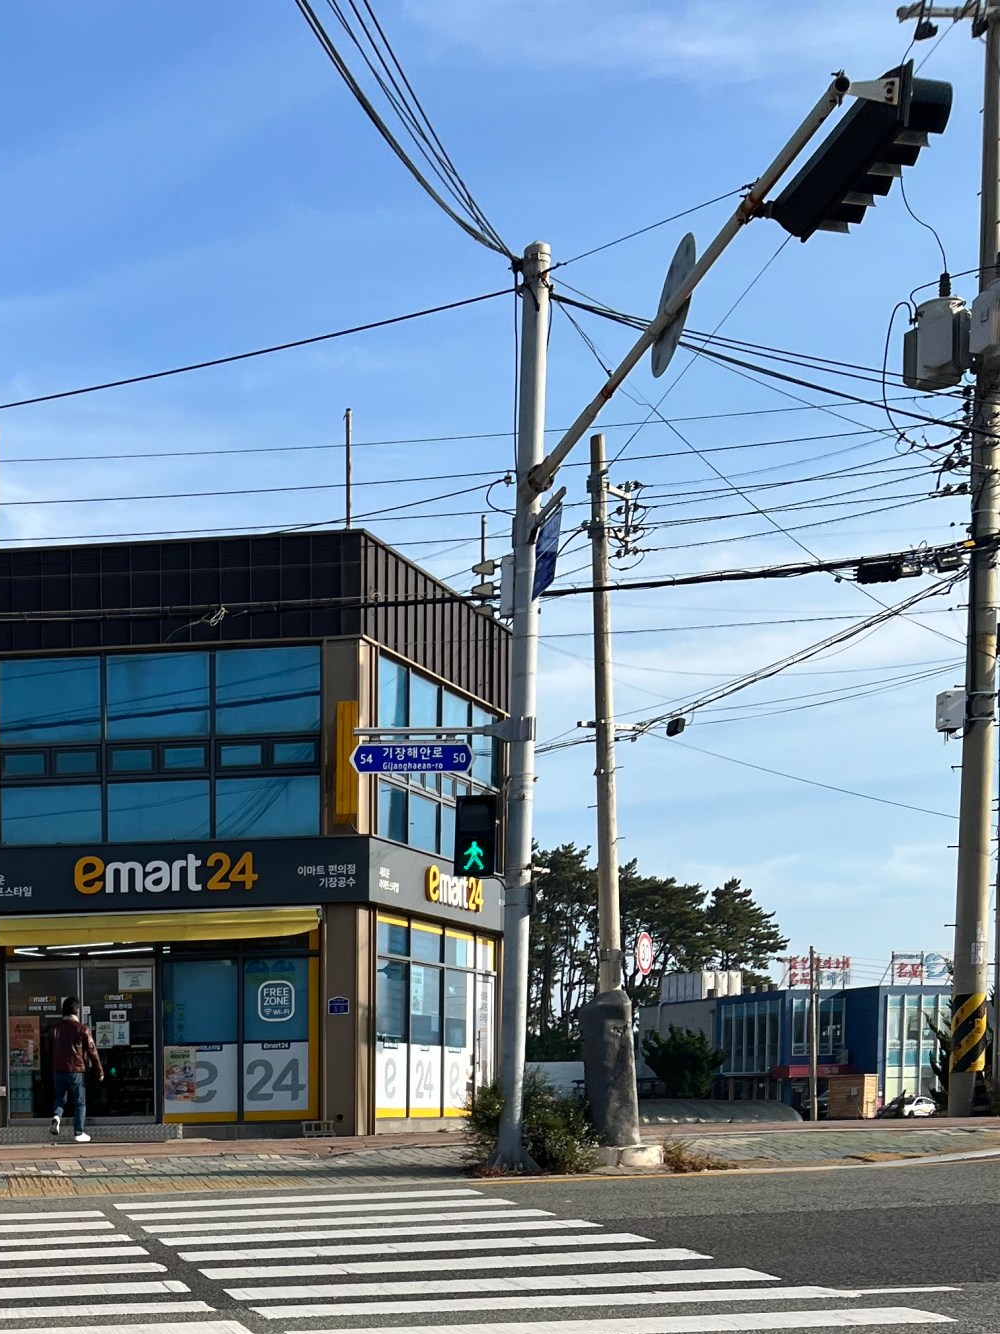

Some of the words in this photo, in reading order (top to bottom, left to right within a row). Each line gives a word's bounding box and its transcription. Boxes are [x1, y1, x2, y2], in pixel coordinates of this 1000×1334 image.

[360, 753, 373, 764] 54
[382, 746, 443, 760] 기장해안로
[453, 752, 466, 763] 50
[382, 761, 443, 771] Gijanghaean-ro
[73, 851, 259, 894] emart24
[297, 865, 326, 876] 이마트
[327, 863, 356, 875] 편의점
[319, 877, 356, 888] 기장공수
[641, 943, 650, 962] 30
[263, 986, 290, 997] FREE
[263, 996, 290, 1005] ZONE
[246, 1058, 306, 1101] 24
[384, 1058, 396, 1099] e
[415, 1060, 434, 1099] 24
